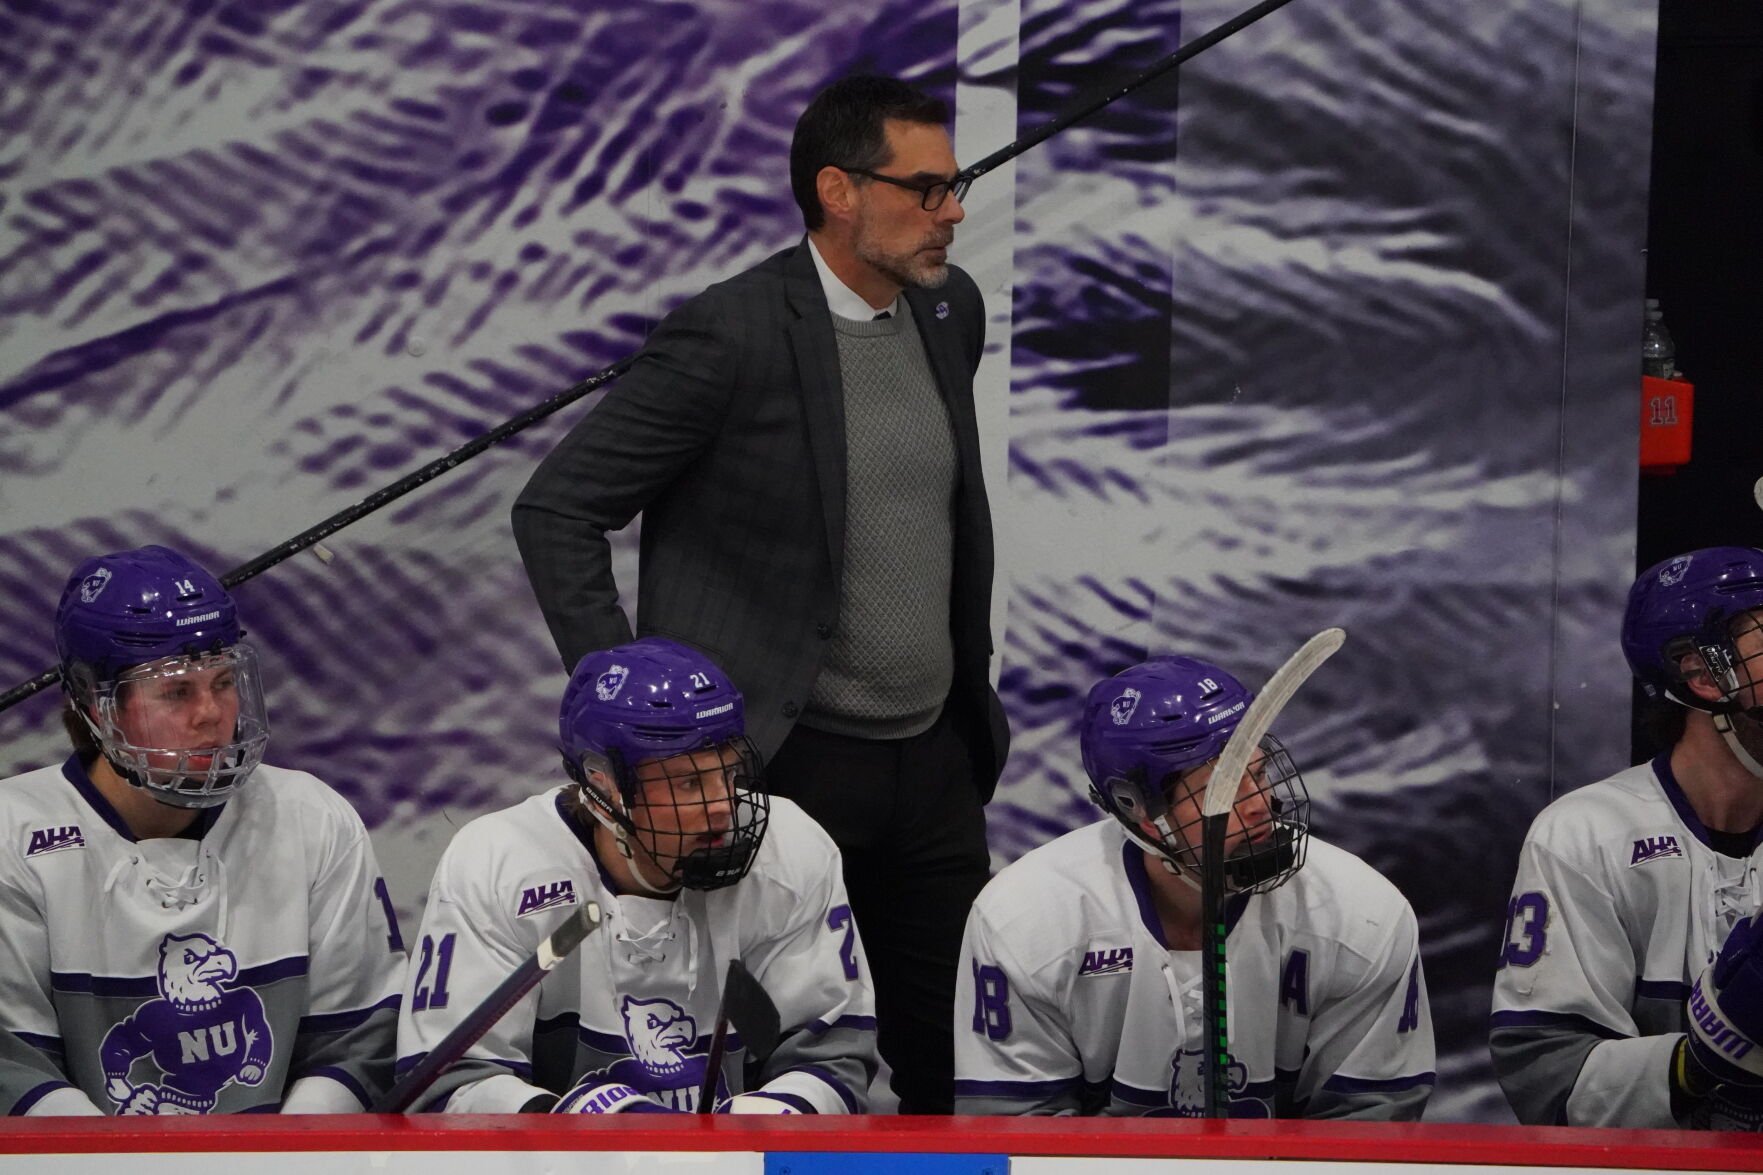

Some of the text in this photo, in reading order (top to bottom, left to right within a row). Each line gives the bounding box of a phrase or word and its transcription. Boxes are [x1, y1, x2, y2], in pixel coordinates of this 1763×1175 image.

[1650, 396, 1678, 426] 11
[175, 579, 196, 594] 14
[176, 611, 220, 627] WARRIOR
[689, 672, 710, 688] 21
[1198, 678, 1218, 694] 18
[696, 702, 733, 719] WARRIOR
[27, 826, 85, 855] AHA
[1630, 836, 1682, 865] AHA
[518, 880, 575, 915] AHA
[374, 877, 405, 952] 1
[826, 905, 859, 981] 2
[412, 933, 457, 1013] 21
[1079, 948, 1133, 975] AHA
[1282, 947, 1310, 1017] A
[972, 958, 1013, 1042] 18
[177, 1021, 237, 1064] NU
